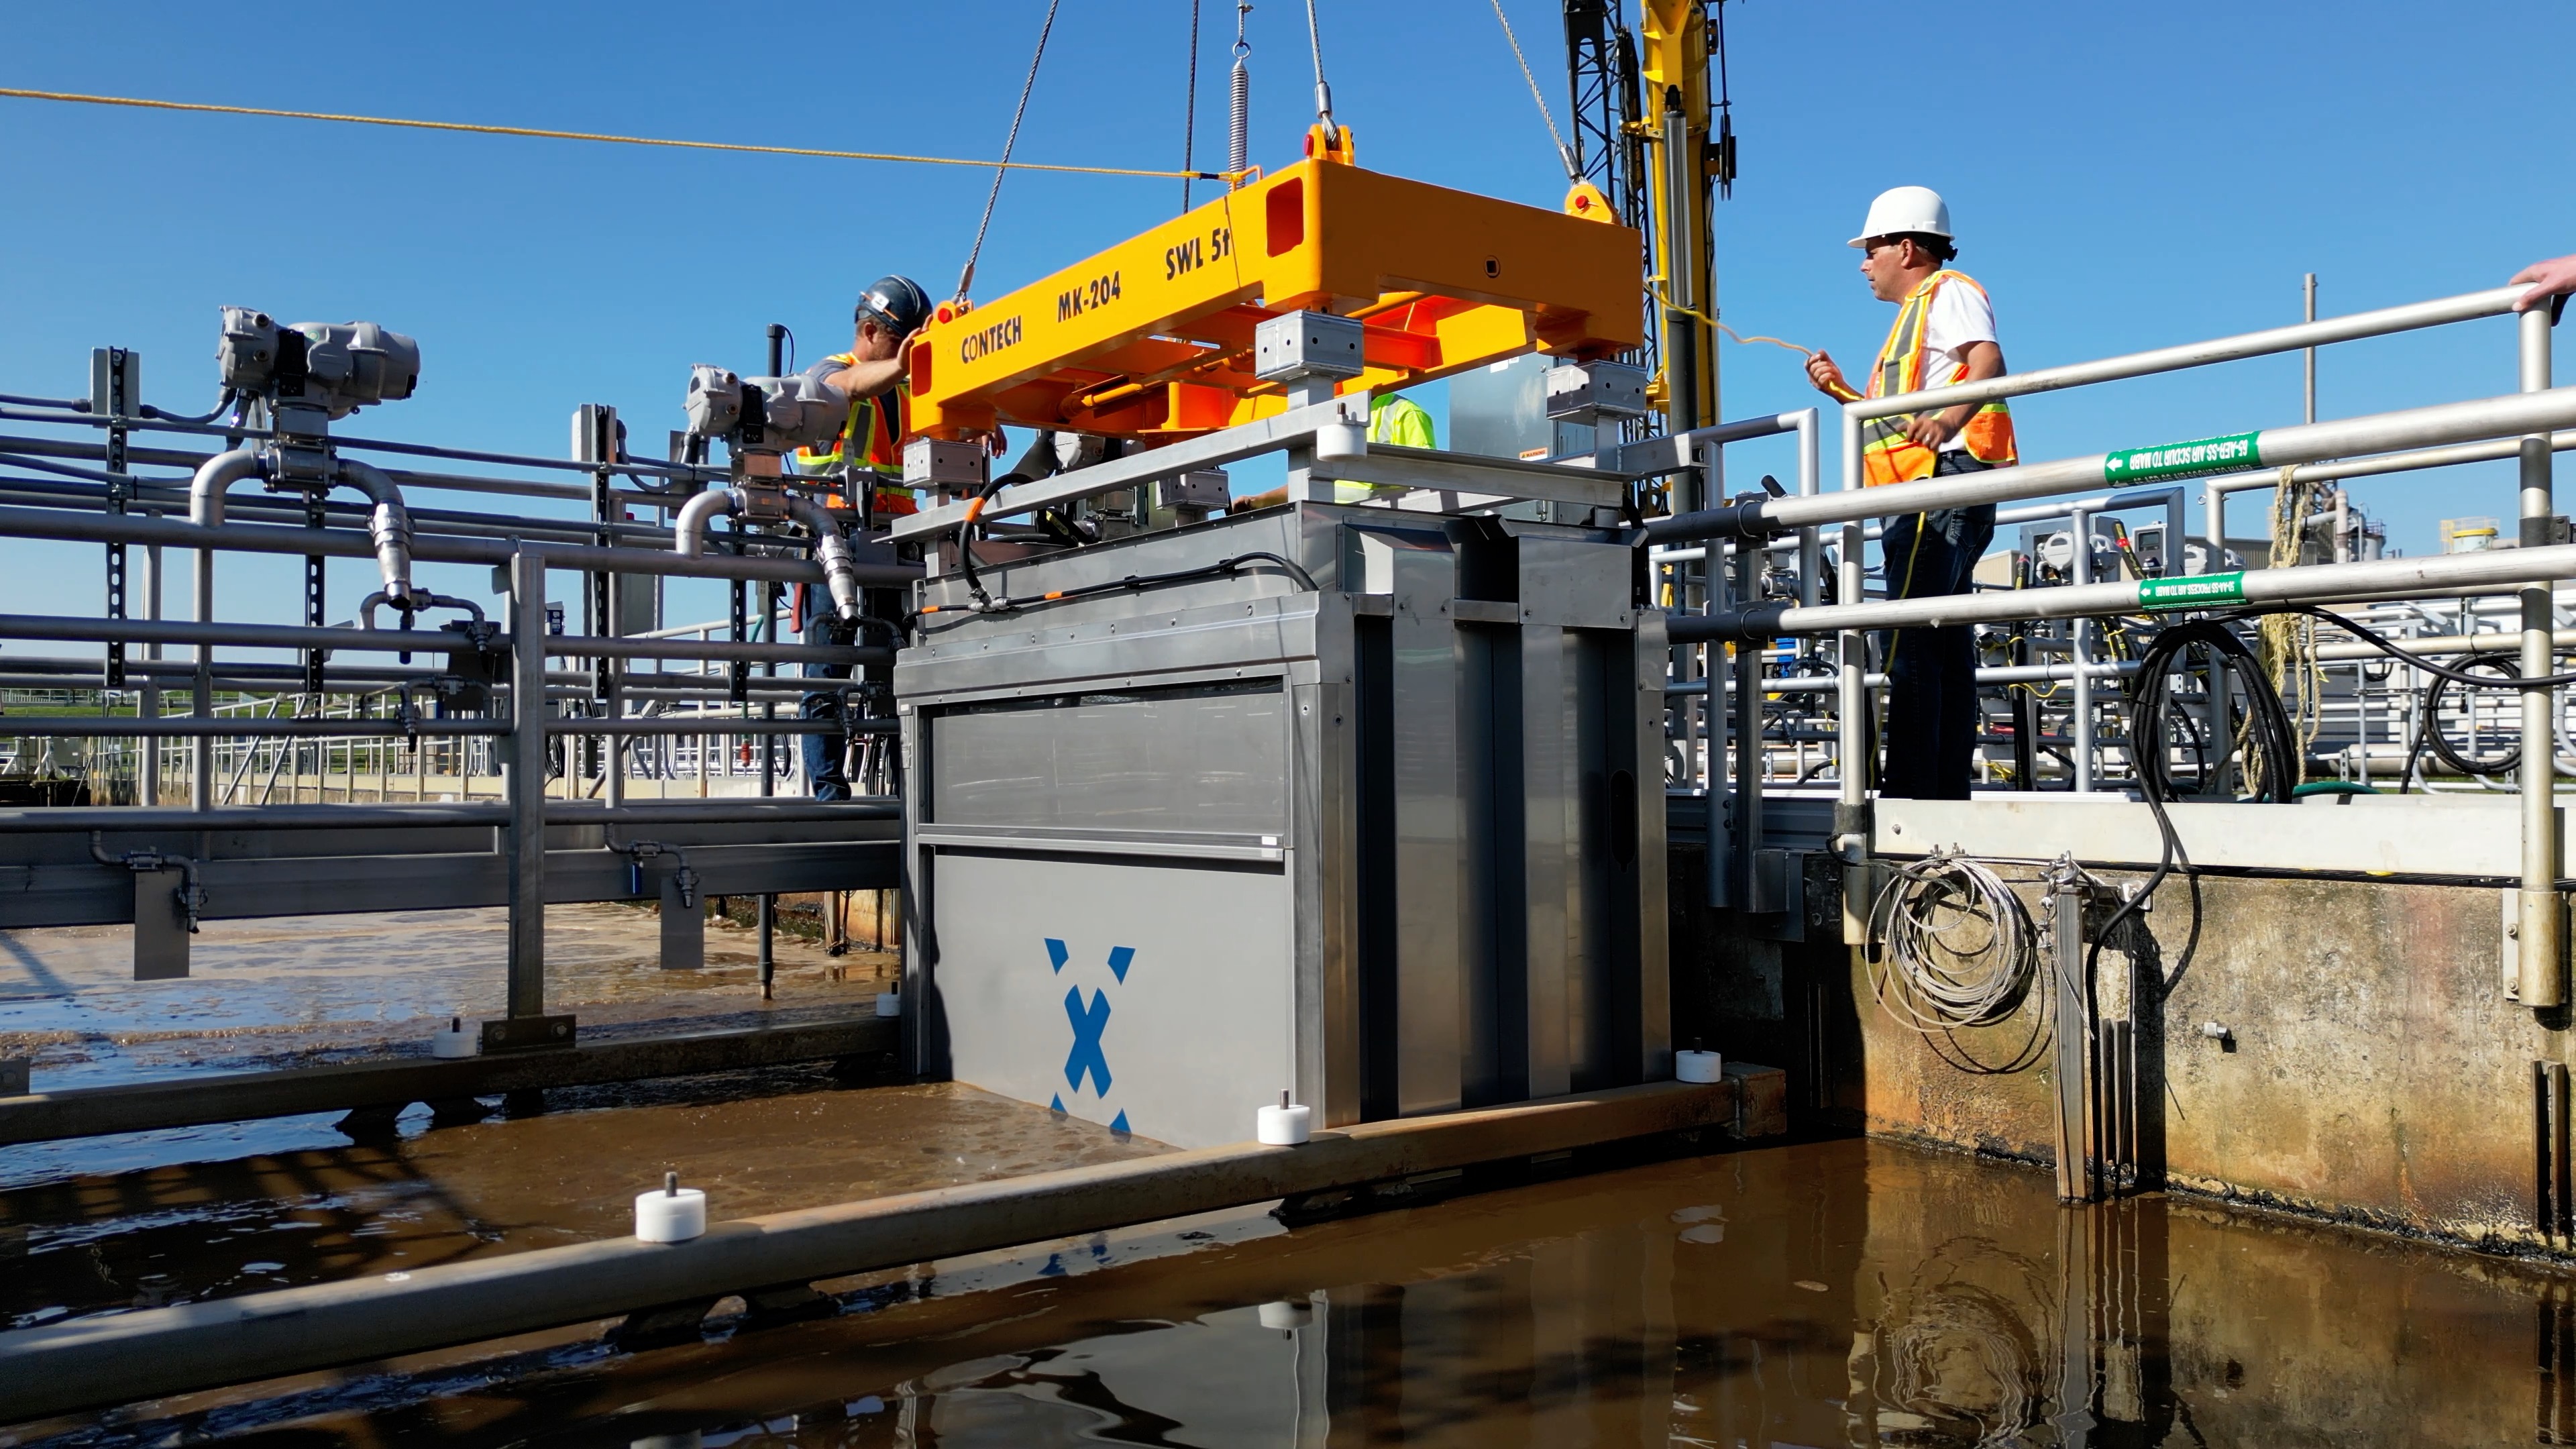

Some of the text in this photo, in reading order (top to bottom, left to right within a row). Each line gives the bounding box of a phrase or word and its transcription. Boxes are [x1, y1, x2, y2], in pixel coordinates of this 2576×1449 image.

[961, 227, 1230, 364] CONTECH MK-204 SWL 5t
[2163, 447, 2192, 466] SCOUR
[2192, 445, 2206, 463] AIR
[2206, 439, 2248, 461] 65-AER-SS
[2129, 452, 2152, 470] MABR
[2152, 451, 2163, 468] TO
[2155, 586, 2170, 596] MABR
[2170, 585, 2178, 596] TO
[2178, 585, 2188, 595] AIR
[2188, 583, 2211, 595] PROCESS
